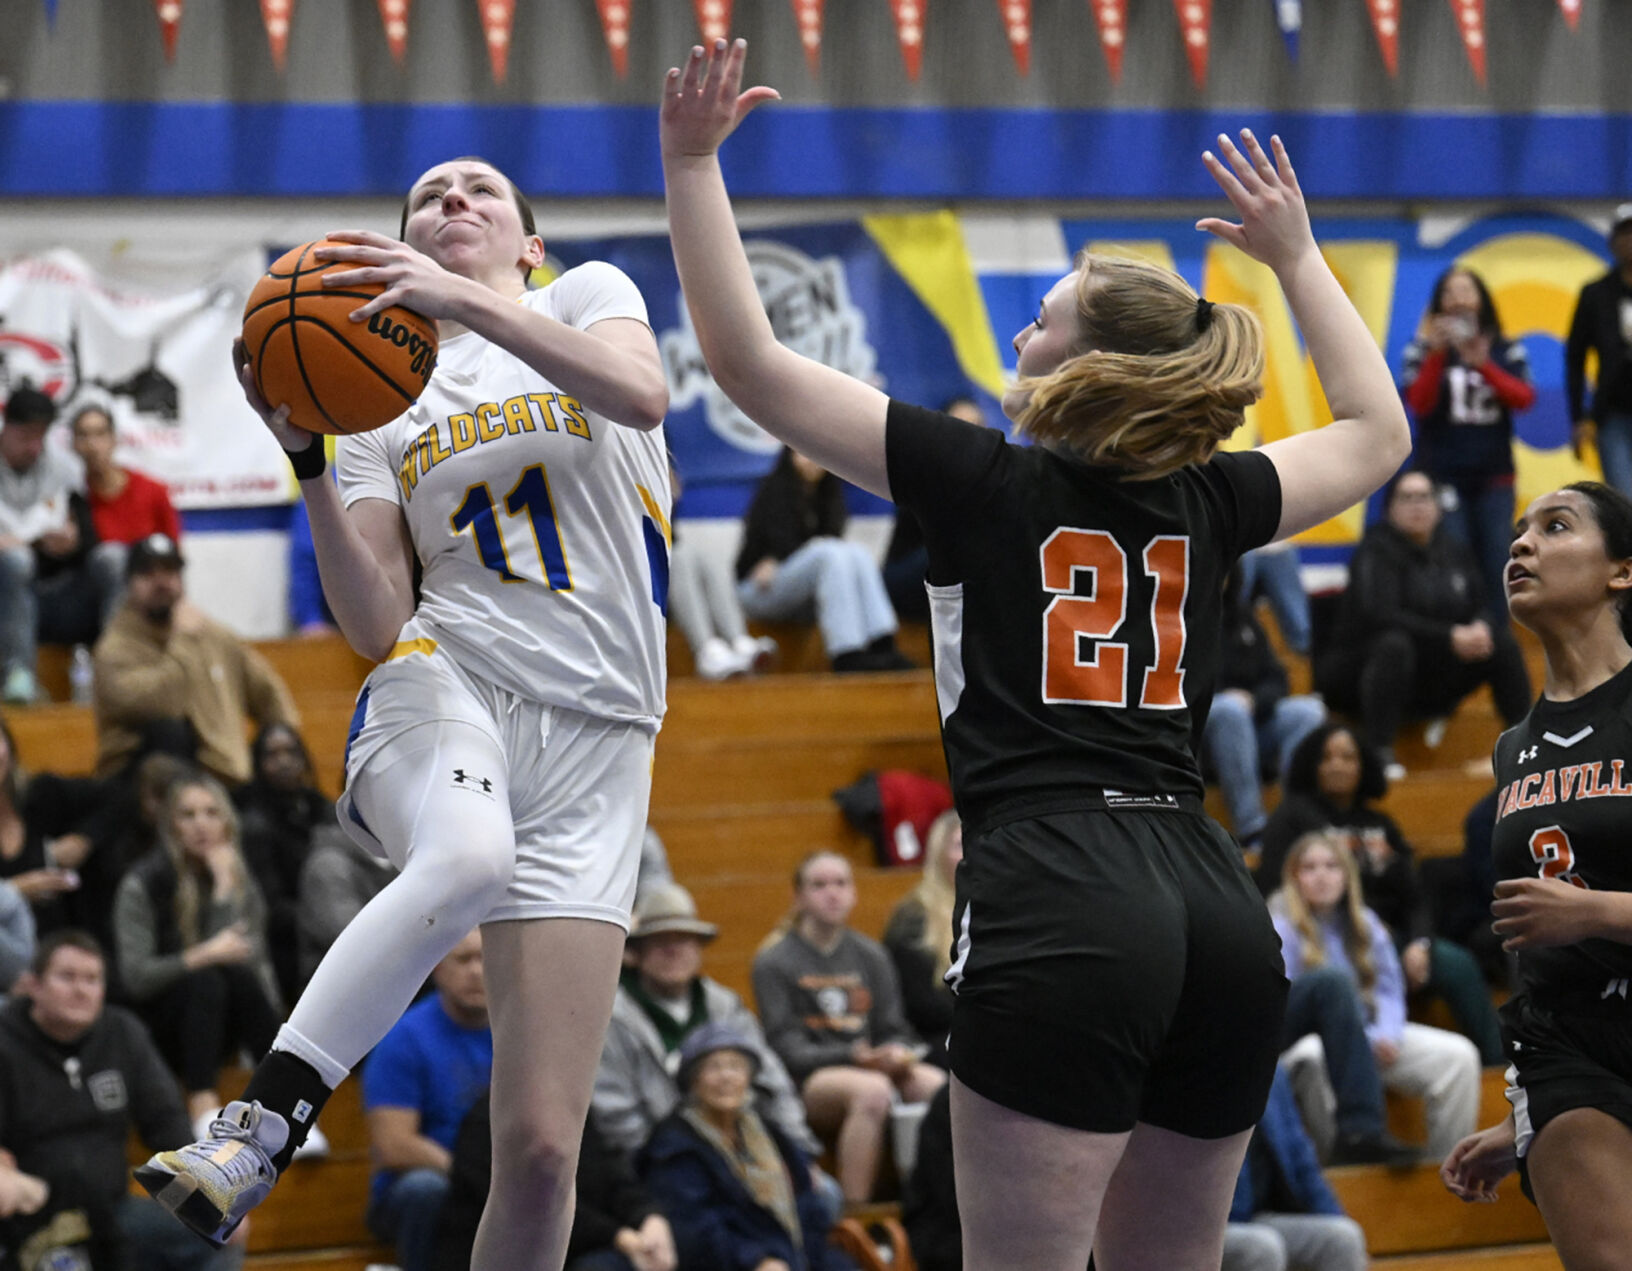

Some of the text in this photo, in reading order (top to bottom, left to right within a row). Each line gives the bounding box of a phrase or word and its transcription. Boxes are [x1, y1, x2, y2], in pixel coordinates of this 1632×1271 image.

[399, 392, 592, 503] WILDCATS
[450, 462, 575, 593] 11
[1039, 526, 1190, 710] 21
[1528, 825, 1590, 889] 2
